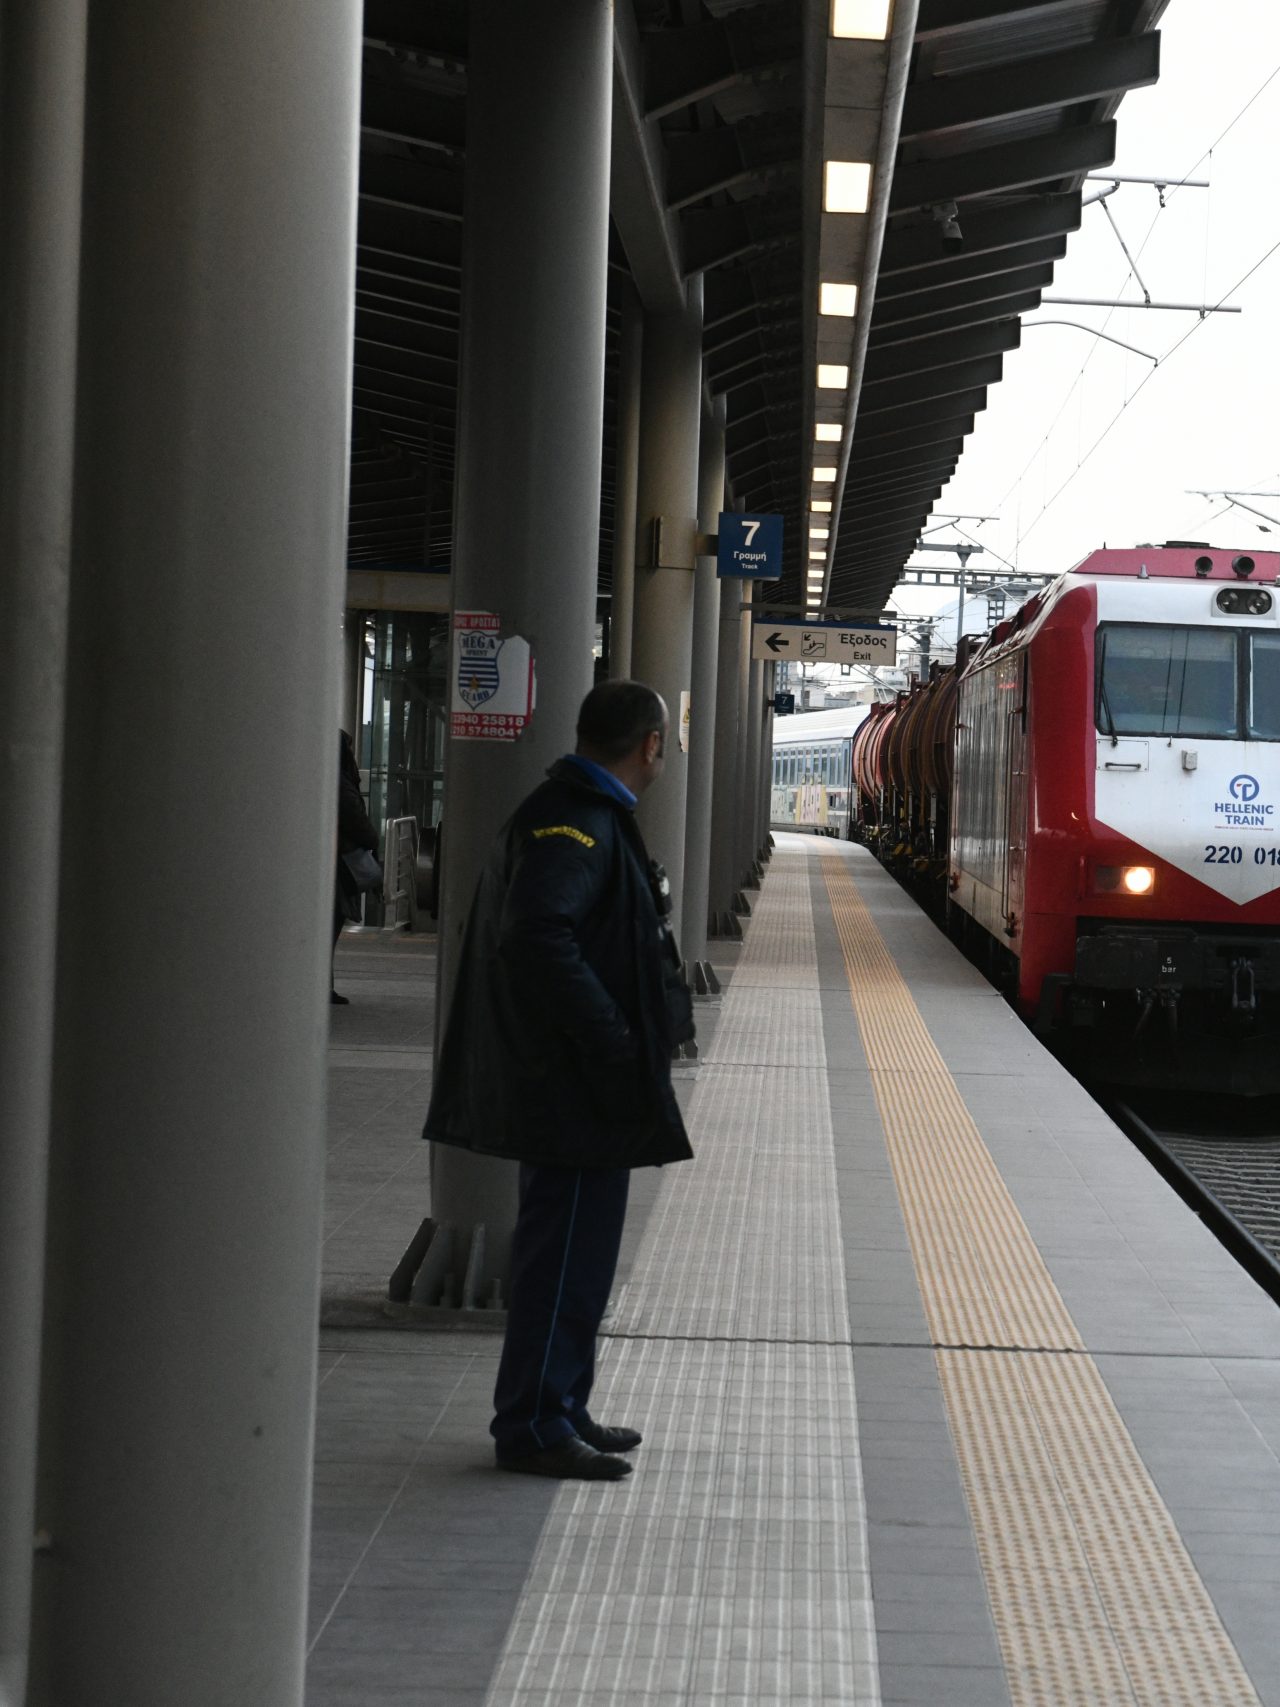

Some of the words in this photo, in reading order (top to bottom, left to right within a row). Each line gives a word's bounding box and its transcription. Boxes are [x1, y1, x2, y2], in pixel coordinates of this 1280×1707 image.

[741, 521, 761, 546] 7
[733, 551, 767, 562] Γραμμή
[461, 636, 496, 650] MEGA
[838, 632, 887, 648] Έξοδος
[853, 651, 872, 661] Exit
[482, 715, 525, 727] 25818
[1214, 803, 1274, 814] HELLENIC
[1225, 815, 1265, 826] TRAIN
[1203, 845, 1243, 864] 220
[1166, 956, 1172, 964] 5
[1161, 965, 1176, 973] bar
